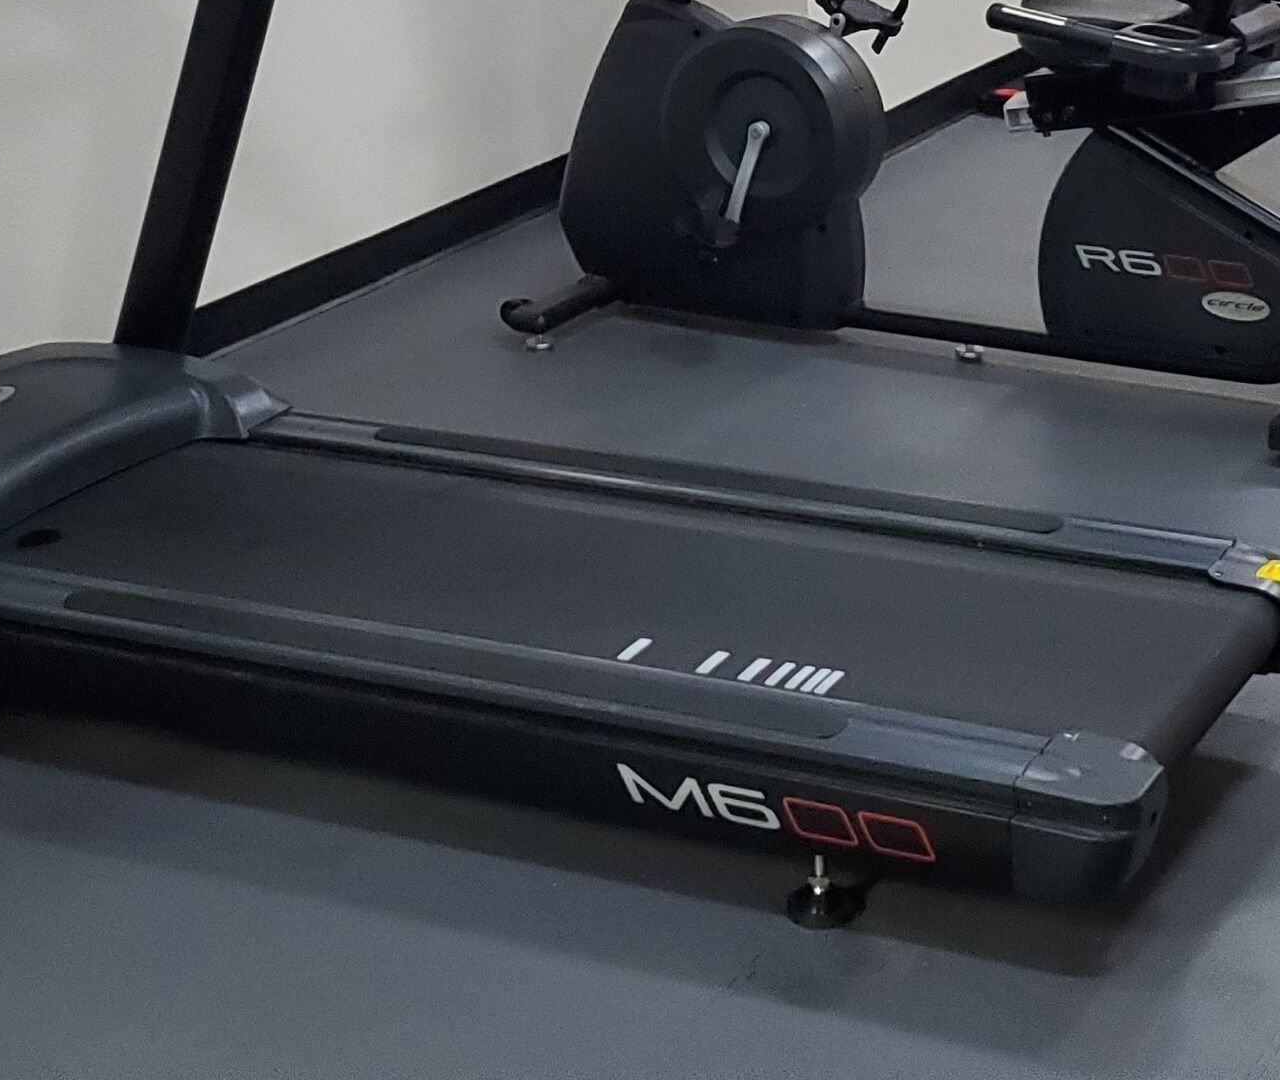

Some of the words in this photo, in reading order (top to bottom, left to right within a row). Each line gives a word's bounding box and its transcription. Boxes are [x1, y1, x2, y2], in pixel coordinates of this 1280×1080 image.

[1074, 244, 1254, 288] R600
[1207, 298, 1265, 312] circle
[616, 762, 936, 863] M600
